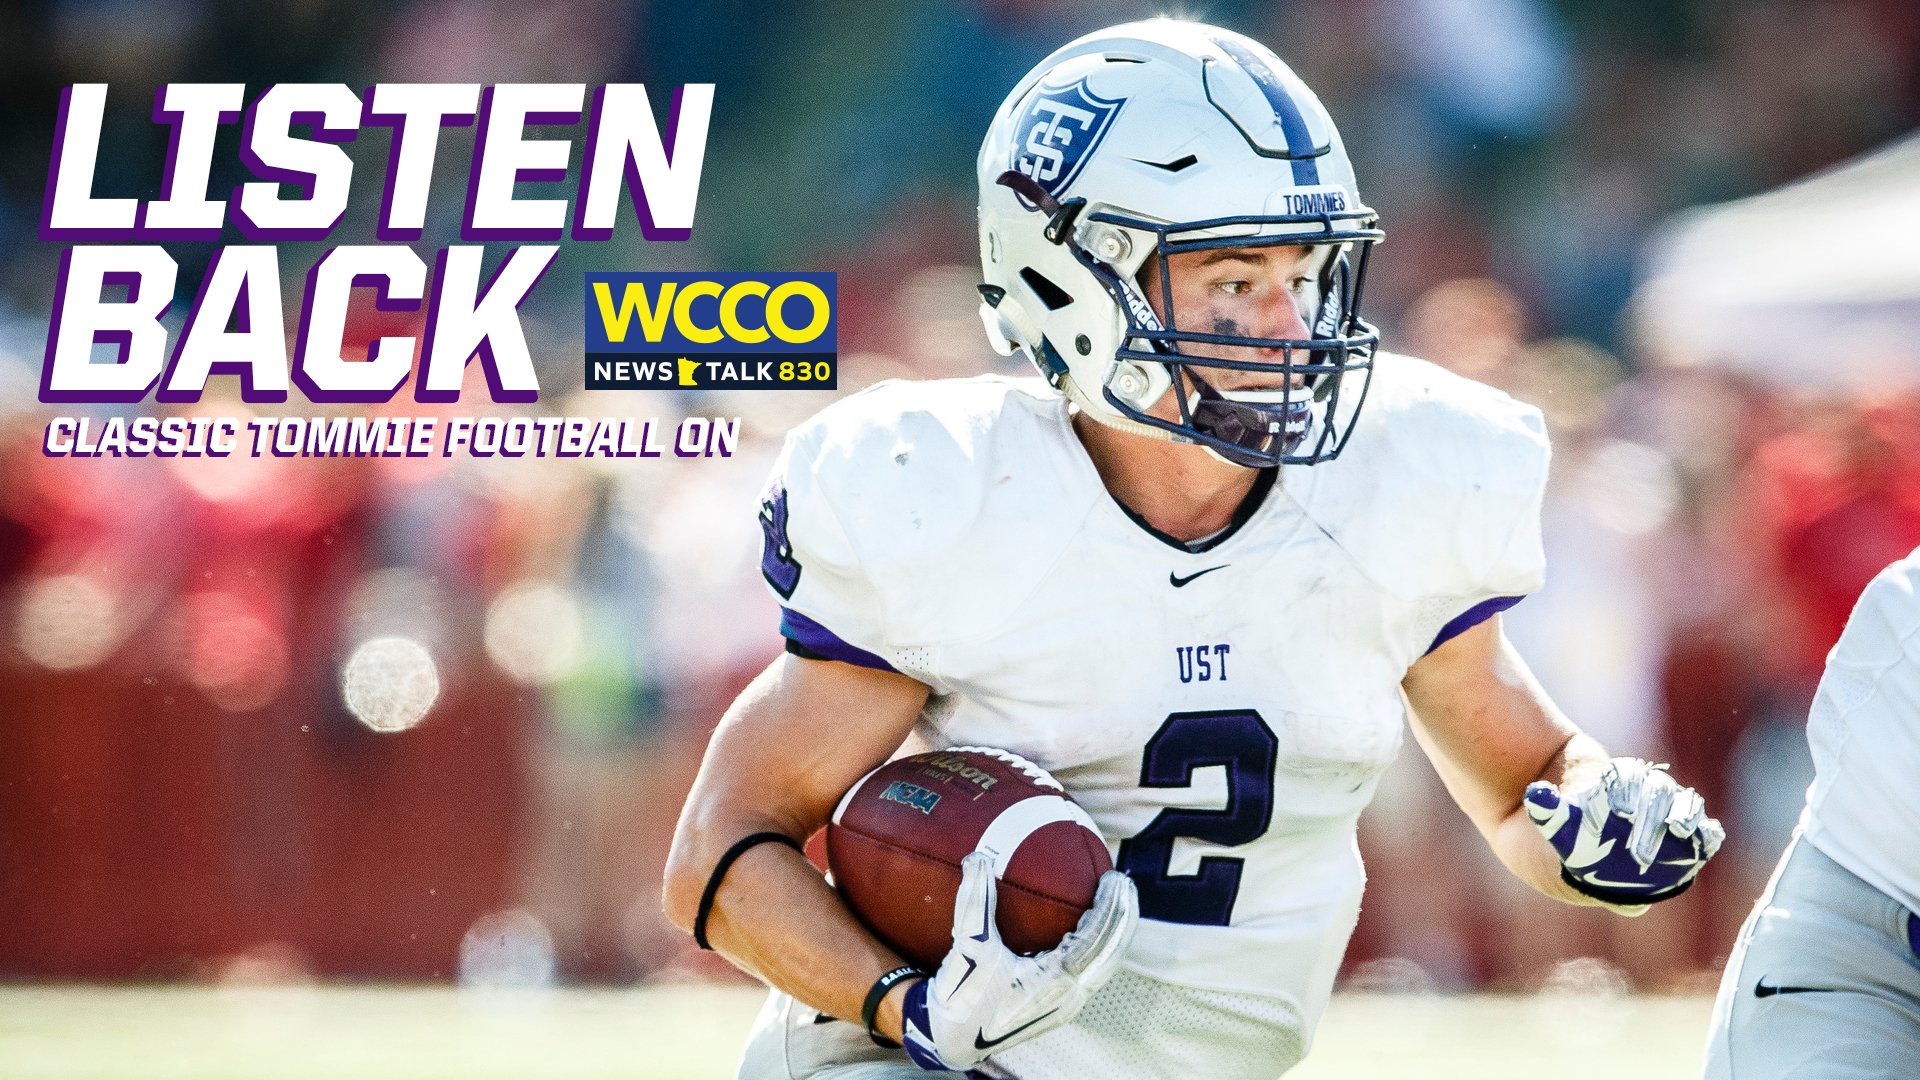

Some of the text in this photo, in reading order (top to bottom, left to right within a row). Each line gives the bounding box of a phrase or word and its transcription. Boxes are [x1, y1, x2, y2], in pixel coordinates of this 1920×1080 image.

[1283, 191, 1346, 215] TOMMIES
[1176, 643, 1230, 683] UST
[878, 780, 942, 815] NCAA
[1115, 708, 1279, 927] 2
